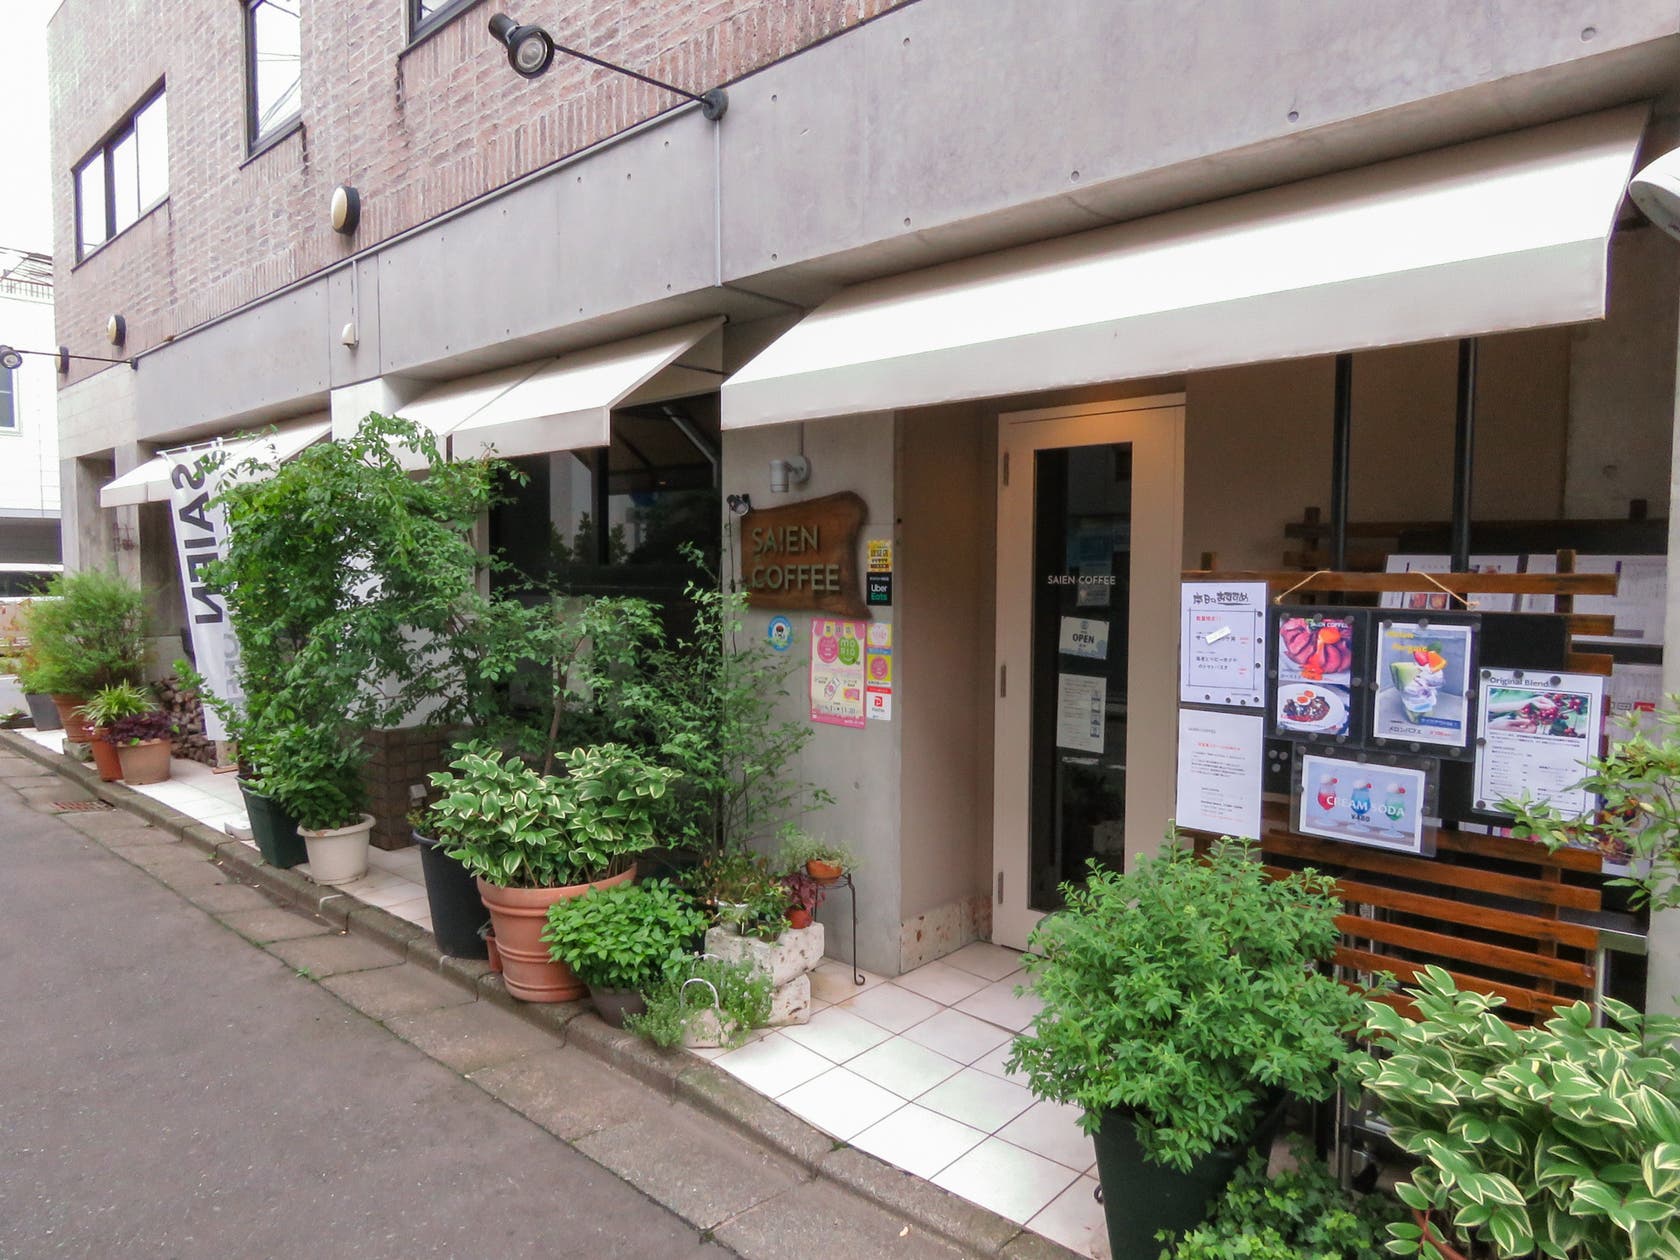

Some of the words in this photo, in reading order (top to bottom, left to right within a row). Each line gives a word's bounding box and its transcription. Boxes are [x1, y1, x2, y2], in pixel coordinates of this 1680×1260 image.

[752, 525, 818, 552] SAIEN
[751, 564, 840, 591] COFFEE
[1047, 575, 1076, 585] SAIEN
[1078, 575, 1117, 585] COFFEE
[870, 584, 888, 592] Uber
[870, 593, 888, 601] Eats
[1072, 633, 1095, 644] OPEN
[1490, 677, 1522, 686] Original
[1524, 679, 1549, 688] Blend
[1326, 796, 1368, 811] CREAM
[1372, 803, 1405, 817] SODA
